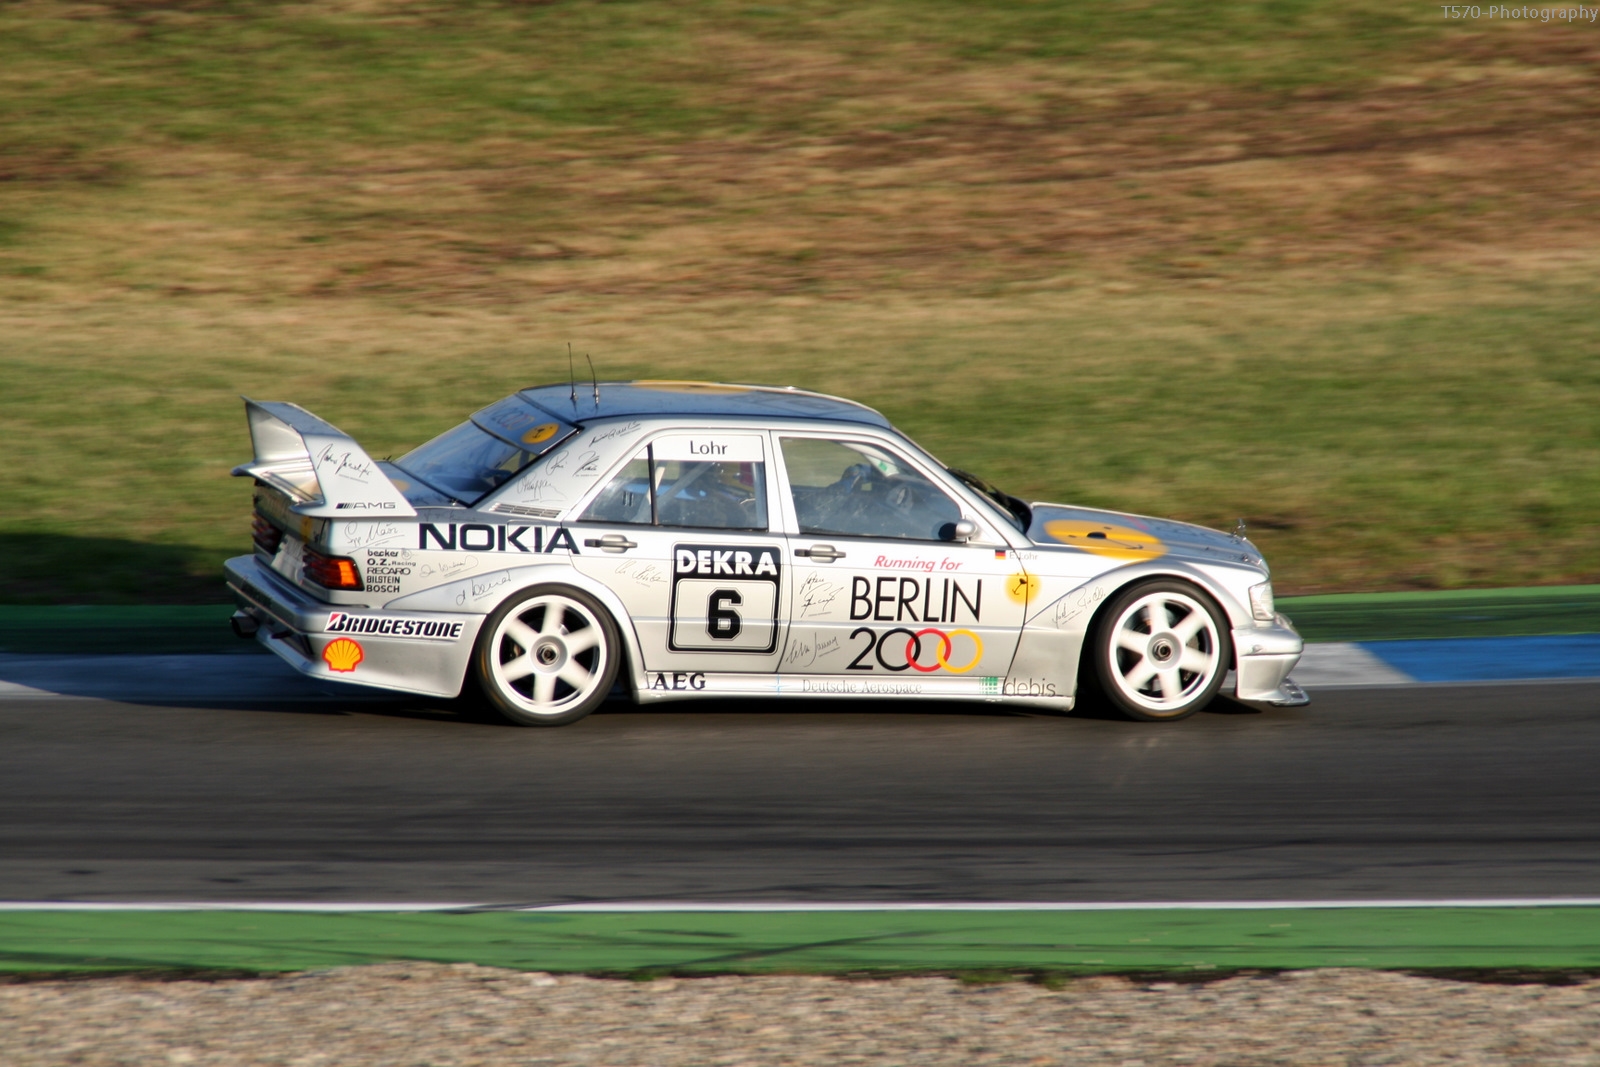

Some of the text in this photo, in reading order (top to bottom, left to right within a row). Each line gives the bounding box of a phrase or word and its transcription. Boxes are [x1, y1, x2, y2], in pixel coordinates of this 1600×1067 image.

[690, 440, 728, 455] Lohr
[419, 523, 581, 555] NOKIA
[367, 549, 399, 557] becker
[676, 549, 778, 576] DEKRA
[874, 555, 963, 572] Running for
[367, 567, 411, 576] RECARO
[367, 576, 400, 584] BILSTEIN
[366, 585, 400, 593] BOSCH
[850, 576, 982, 623] BERLIN
[707, 589, 742, 639] 6
[326, 613, 463, 638] BRIDGESTONE
[845, 627, 984, 673] 2000
[651, 673, 706, 690] AEG
[802, 679, 922, 694] Deutsche Aerospace
[1004, 677, 1056, 697] debis
